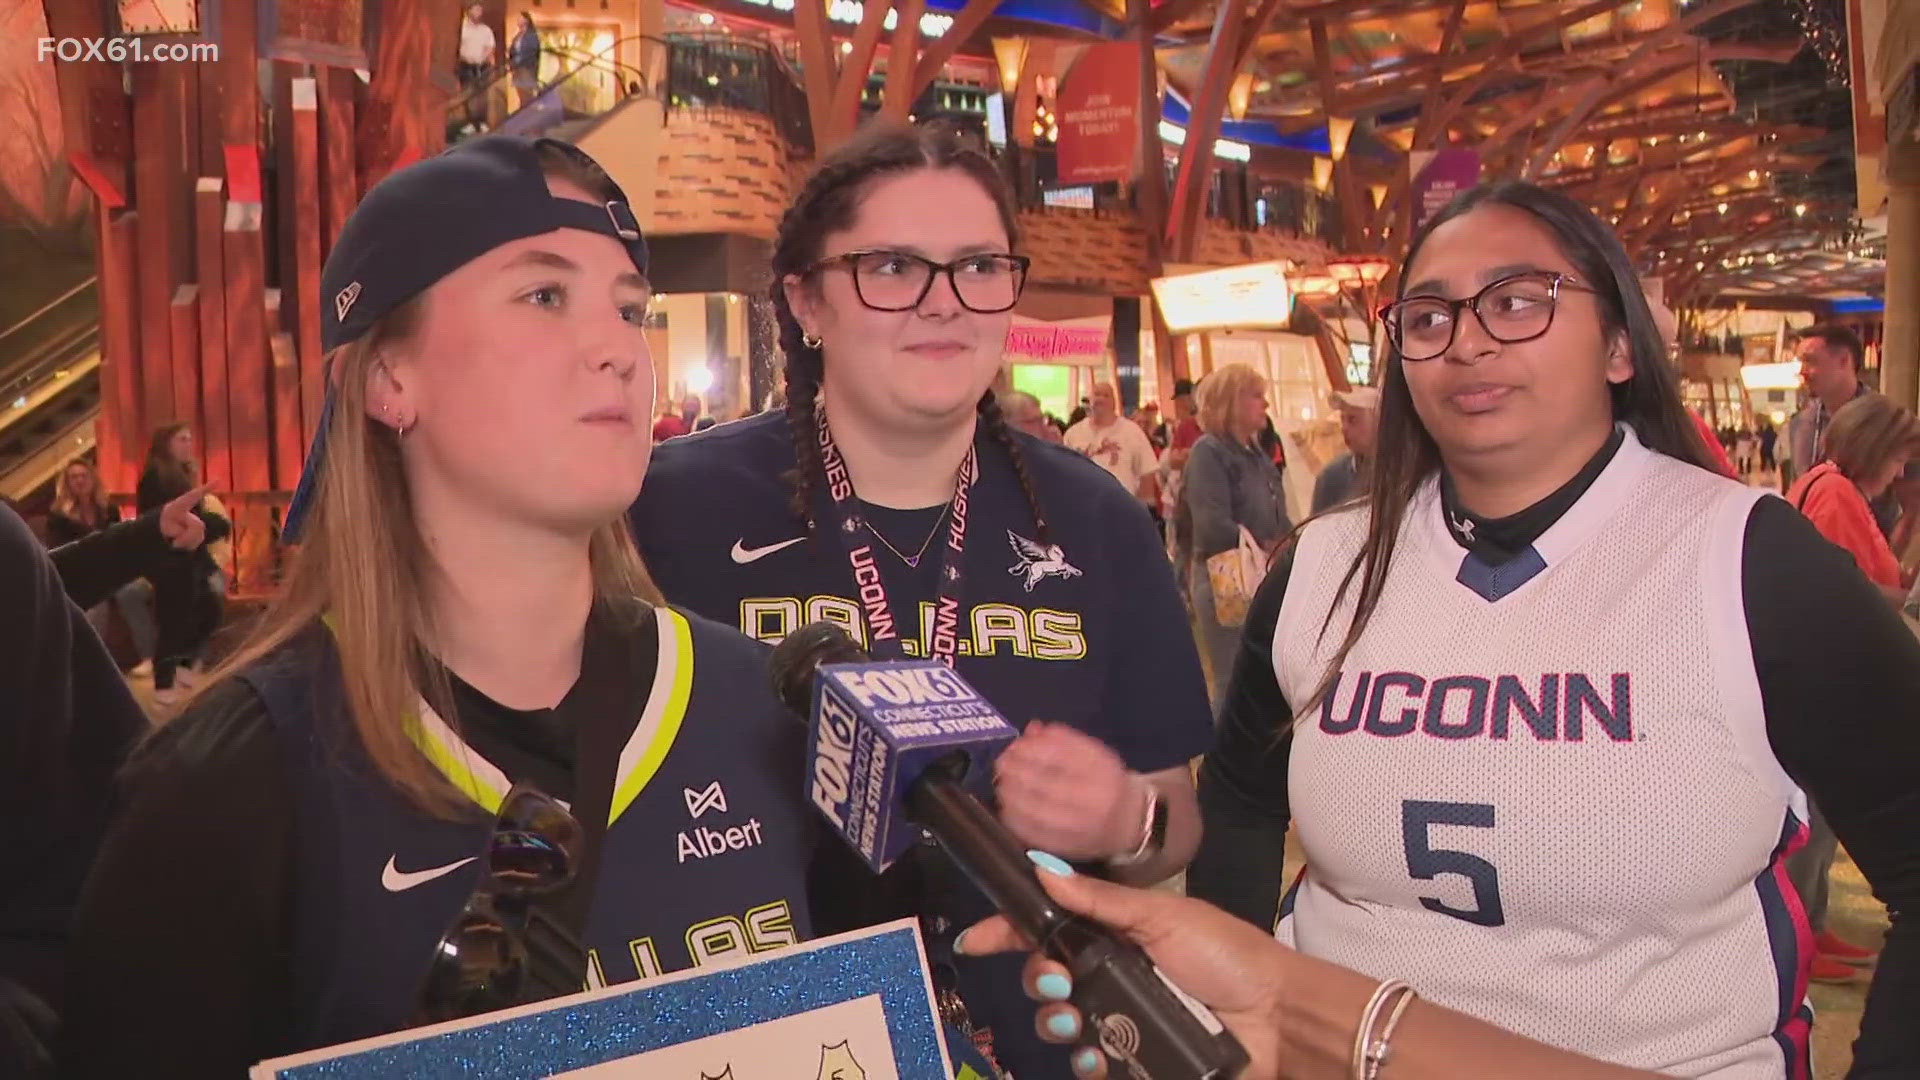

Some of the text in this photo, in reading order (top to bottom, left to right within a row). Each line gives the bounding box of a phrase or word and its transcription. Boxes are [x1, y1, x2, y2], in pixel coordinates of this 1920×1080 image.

[850, 545, 896, 641] UCONN
[933, 597, 958, 669] CONN
[832, 667, 977, 707] FOX61
[1318, 670, 1634, 743] UCONN
[811, 683, 858, 831] FOX61
[886, 715, 1008, 739] NEWS STATION
[859, 734, 889, 861] NEWS STATION
[677, 817, 763, 864] Albert
[1401, 799, 1505, 928] 5
